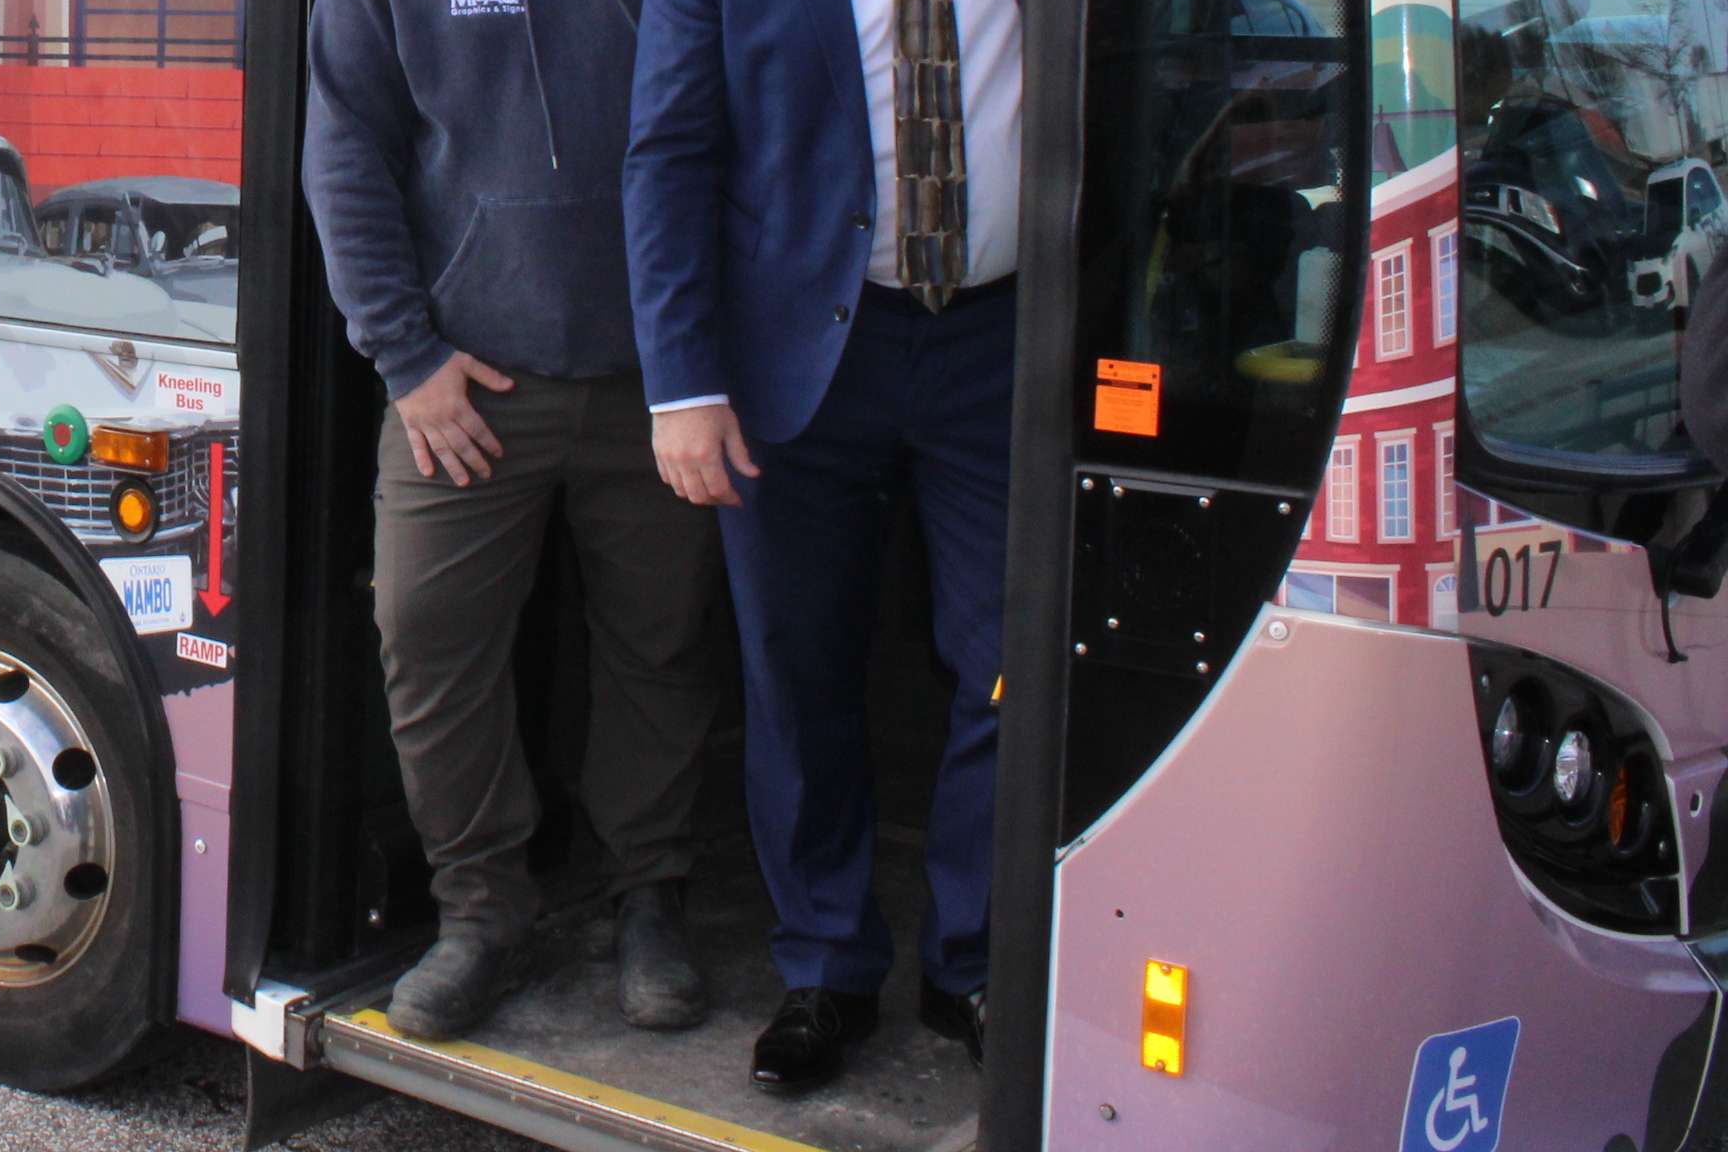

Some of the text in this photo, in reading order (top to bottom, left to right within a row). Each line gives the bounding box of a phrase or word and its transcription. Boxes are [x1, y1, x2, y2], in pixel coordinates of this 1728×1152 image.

[450, 5, 490, 16] Graphics
[158, 372, 223, 398] Kneeling
[175, 393, 205, 411] Bus
[1484, 539, 1563, 617] 017
[123, 577, 173, 616] WAMBO
[179, 635, 225, 664] RAMP
